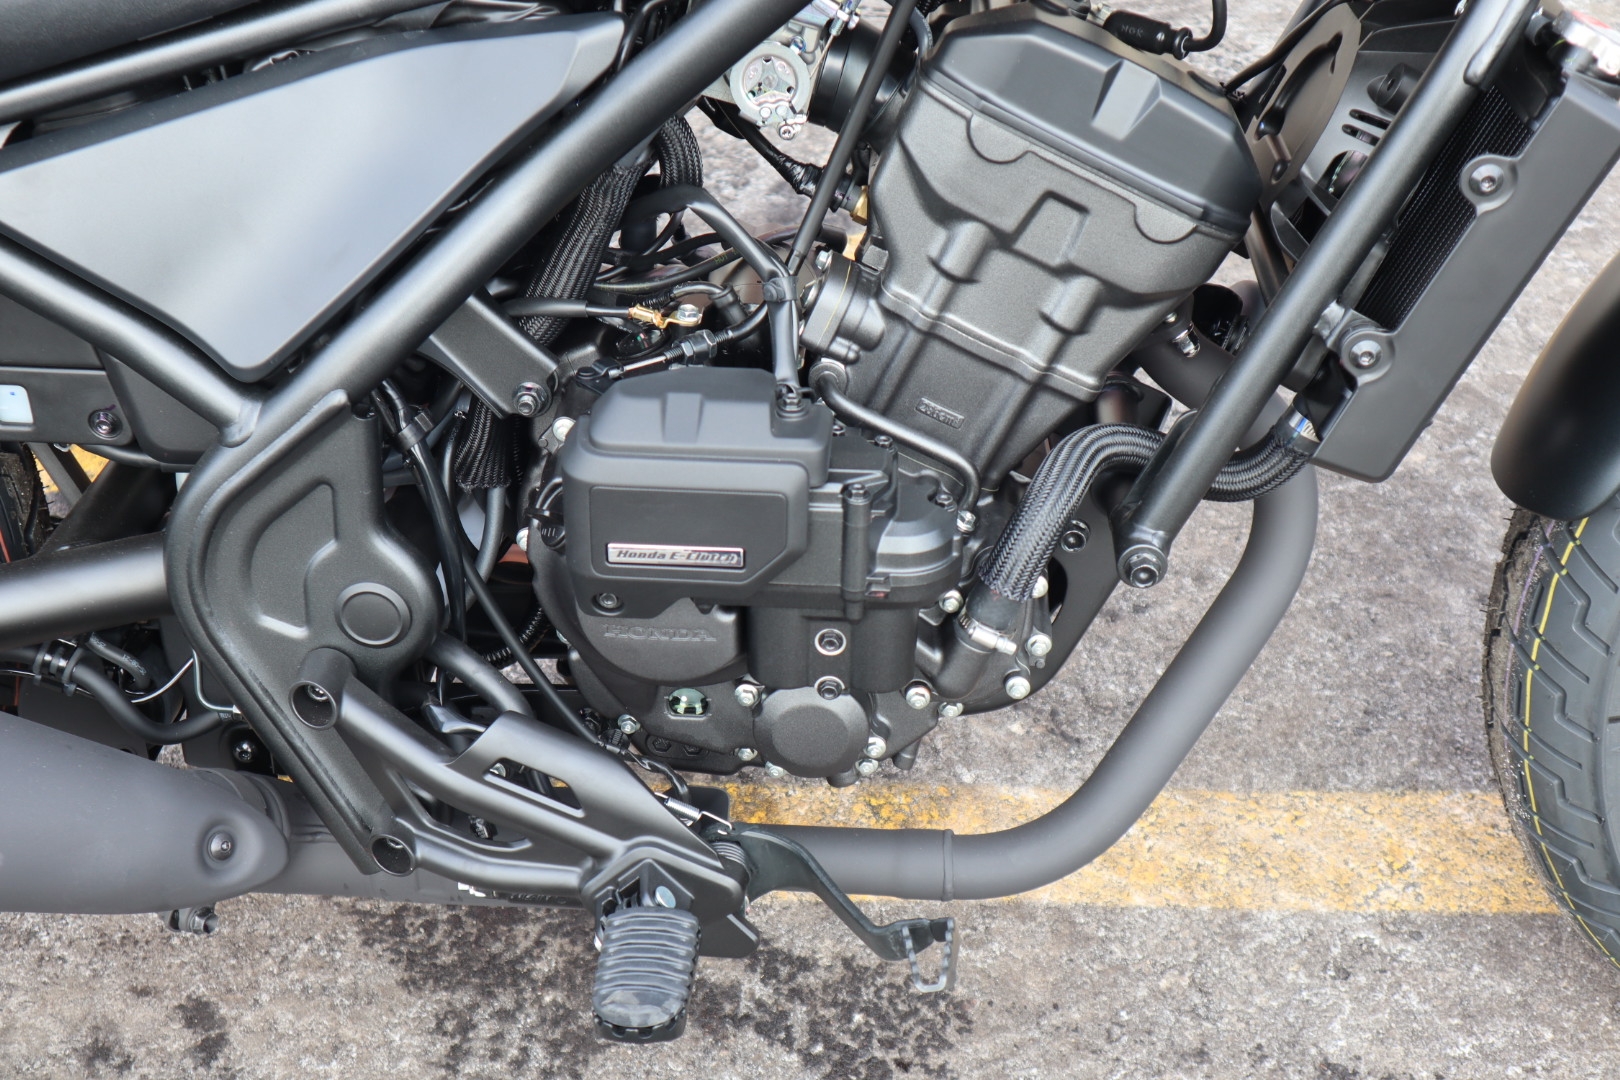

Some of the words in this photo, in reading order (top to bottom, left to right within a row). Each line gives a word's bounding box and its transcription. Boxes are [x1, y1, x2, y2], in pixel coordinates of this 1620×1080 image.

[616, 550, 666, 561] Honda
[669, 551, 738, 564] E-Clutch
[603, 623, 717, 641] HONDA
